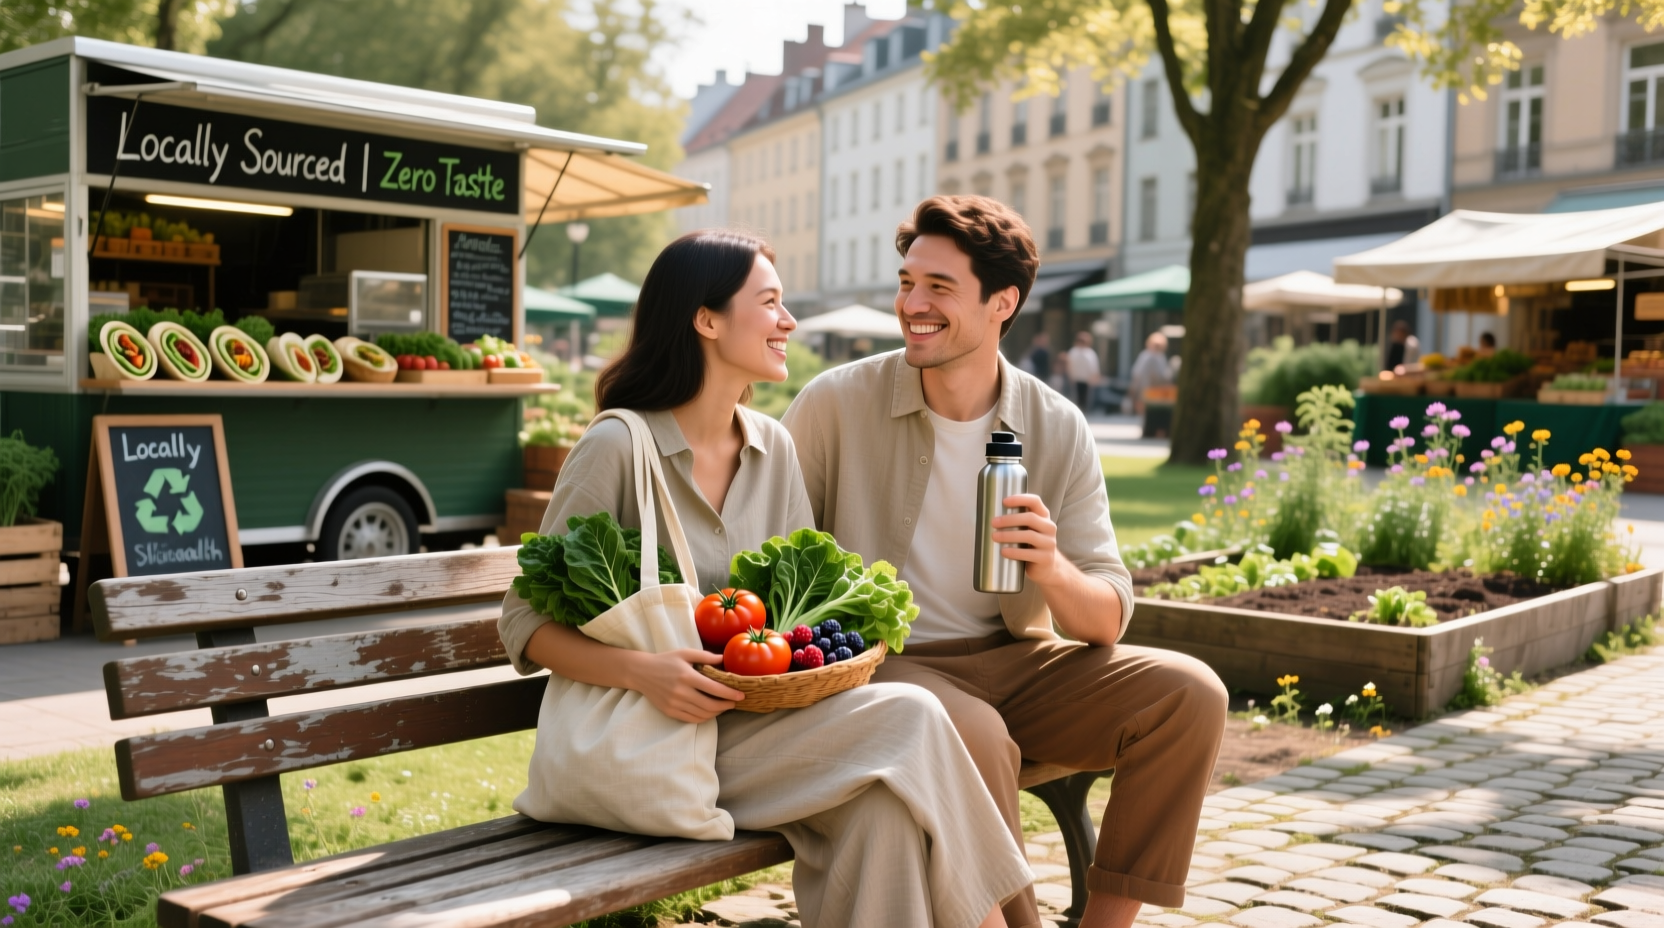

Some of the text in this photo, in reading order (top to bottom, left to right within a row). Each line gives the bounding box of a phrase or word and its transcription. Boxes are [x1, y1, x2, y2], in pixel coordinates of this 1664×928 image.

[116, 112, 229, 184] Locally
[240, 127, 347, 184] Sourced
[379, 151, 436, 193] Zero
[121, 432, 201, 469] Locally
